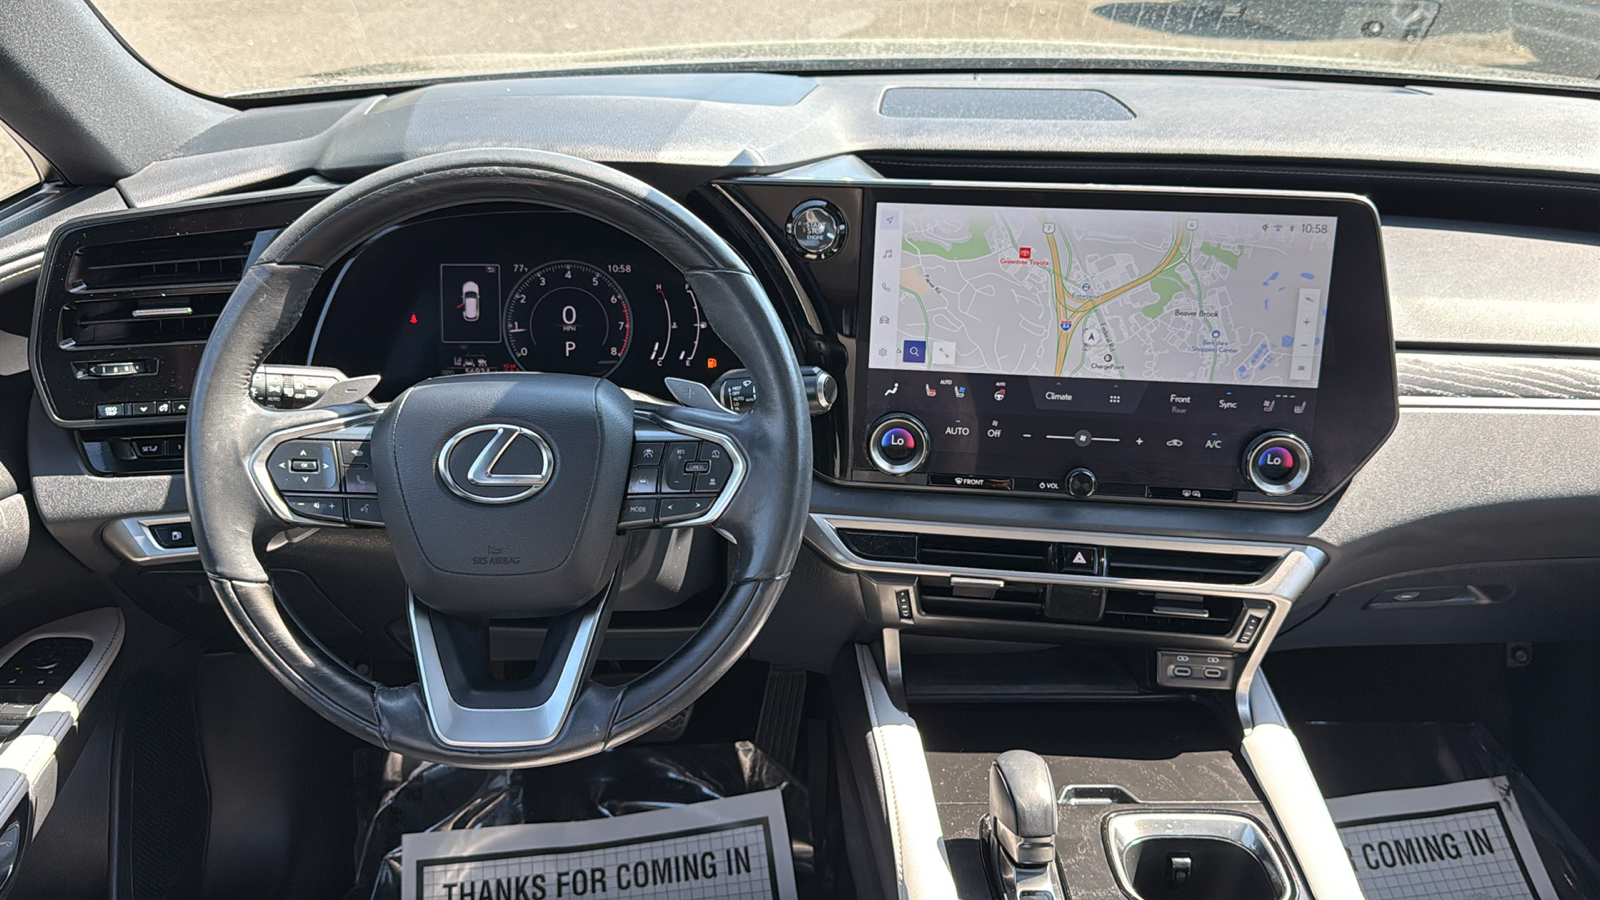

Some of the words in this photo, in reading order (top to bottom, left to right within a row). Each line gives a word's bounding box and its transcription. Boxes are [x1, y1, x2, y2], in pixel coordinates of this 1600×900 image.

[805, 221, 826, 229] START
[1301, 223, 1328, 234] 10:58
[607, 264, 632, 273] 10:58
[564, 270, 572, 279] 4
[539, 277, 546, 286] 3
[592, 277, 599, 286] 5
[519, 294, 527, 304] 2
[610, 294, 618, 304] 6
[562, 305, 577, 325] 0
[1174, 309, 1197, 317] Beaver
[1198, 309, 1219, 318] Brook
[513, 321, 519, 330] 1
[618, 321, 625, 331] 7
[1100, 322, 1112, 343] Federal
[1107, 342, 1116, 353] Rd
[520, 347, 528, 356] 0
[565, 341, 577, 357] P
[610, 347, 618, 356] 8
[1218, 346, 1238, 354] Center
[1090, 363, 1125, 371] ChargePoint
[1044, 391, 1073, 401] Climate
[1169, 393, 1191, 404] Front
[1171, 405, 1187, 414] Rear
[1218, 399, 1238, 410] Sync
[945, 426, 970, 436] AUTO
[987, 428, 1002, 438] Off
[890, 434, 905, 446] Lo
[1204, 440, 1223, 449] A/C
[1266, 453, 1282, 465] Lo
[963, 478, 984, 486] FRONT
[472, 556, 488, 565] SRS
[489, 556, 521, 565] AIRBAG
[1361, 832, 1463, 871] COMING
[1463, 827, 1496, 857] IN
[443, 873, 547, 900] THANKS
[556, 867, 608, 899] FOR
[616, 850, 717, 891] COMING
[725, 846, 752, 877] IN
